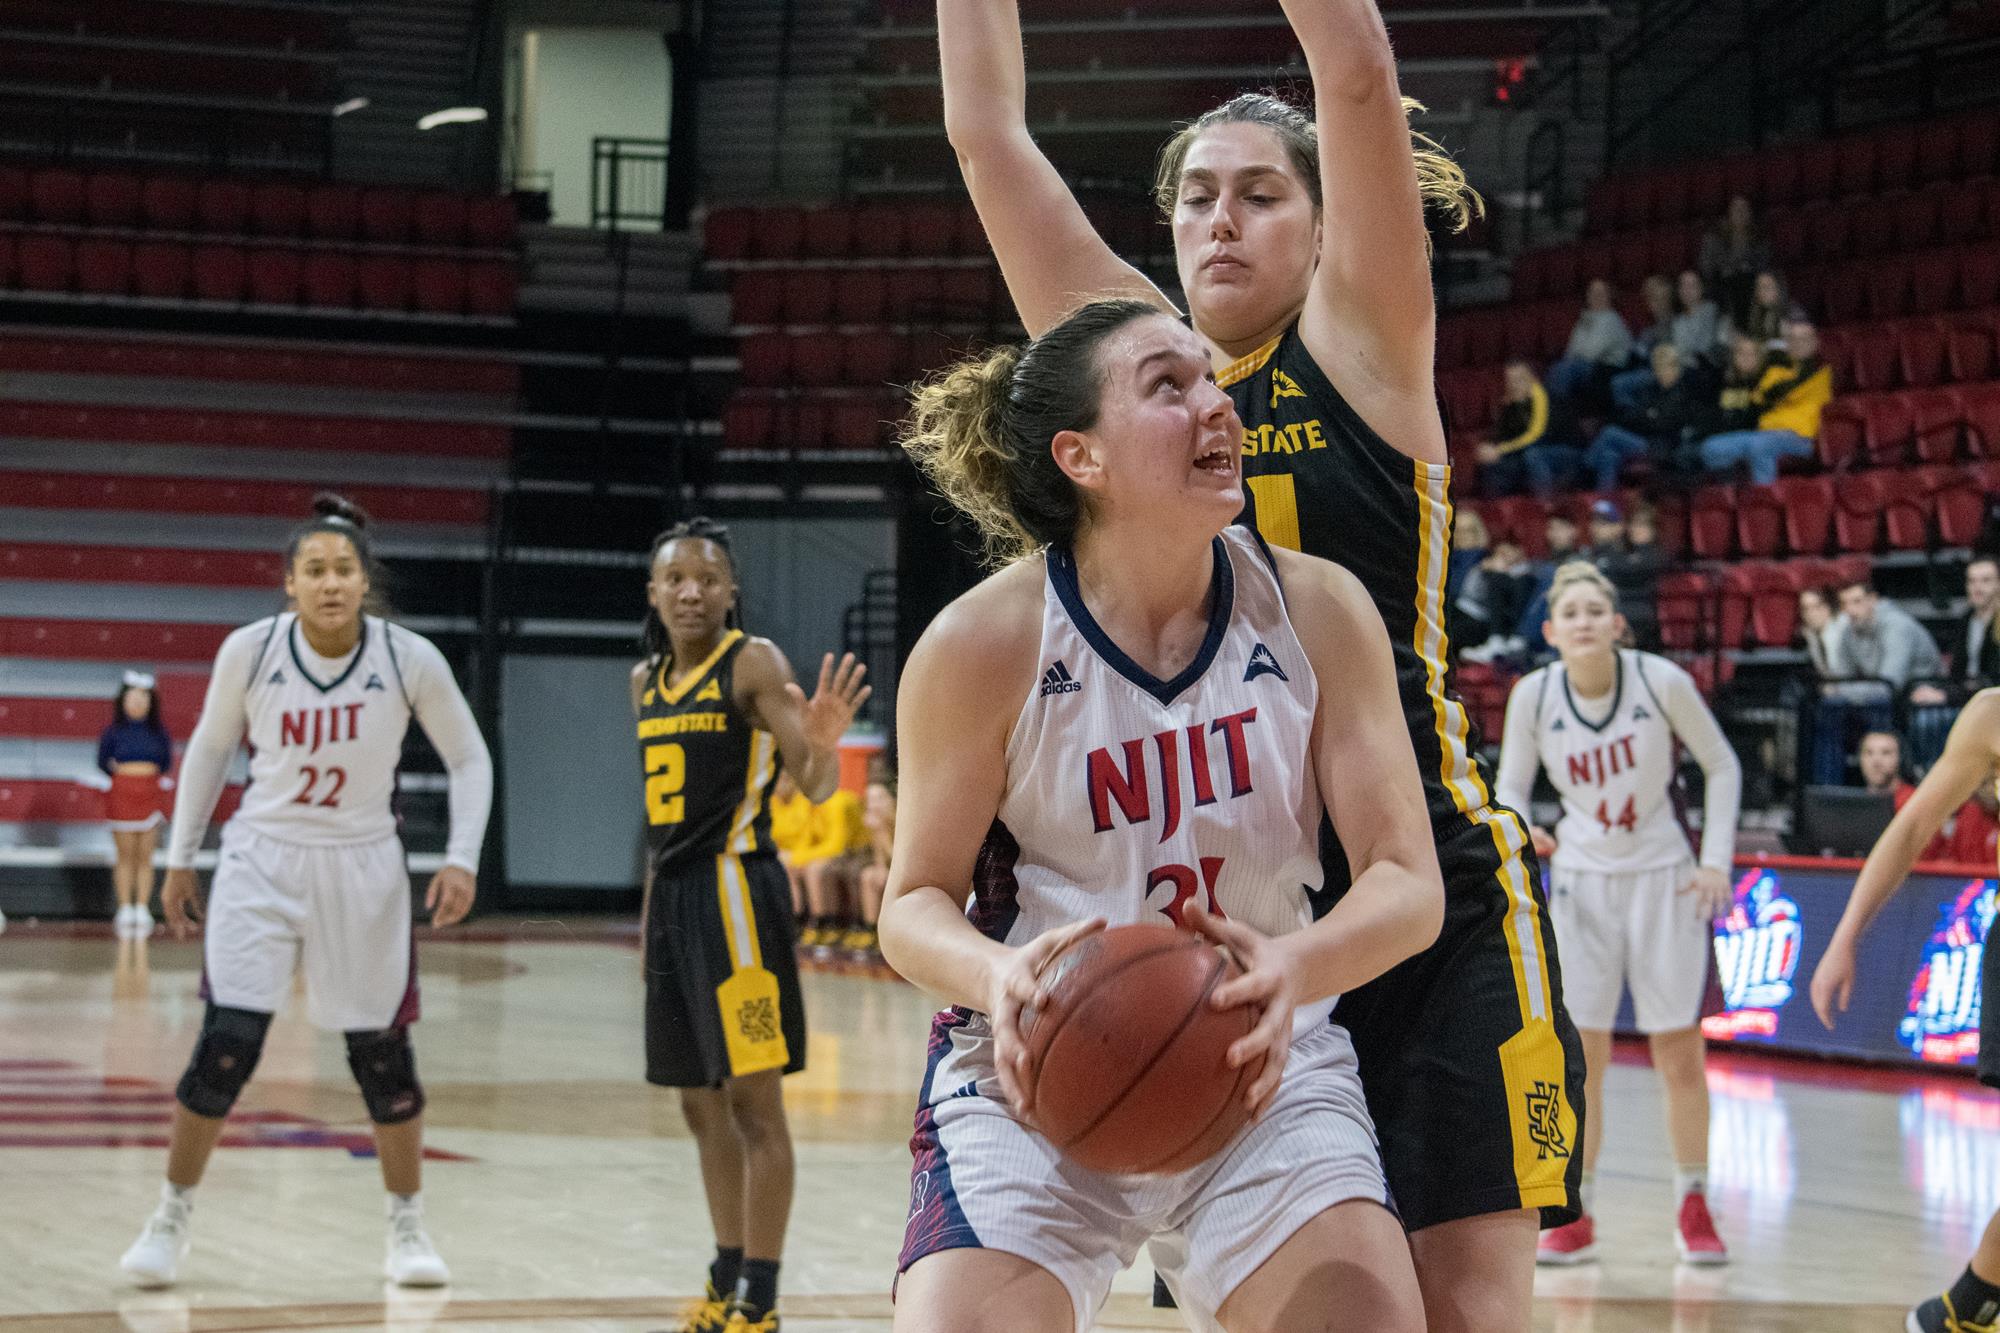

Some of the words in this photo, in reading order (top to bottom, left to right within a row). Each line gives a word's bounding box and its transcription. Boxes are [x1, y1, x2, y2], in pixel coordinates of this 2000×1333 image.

[1241, 419, 1327, 456] STATE
[281, 703, 364, 754] NJIT
[292, 765, 347, 808] 22
[645, 743, 686, 826] 2
[1087, 706, 1257, 845] NJIT
[1568, 734, 1634, 787] NJIT
[1595, 794, 1637, 833] 44
[1145, 856, 1226, 928] 31
[1926, 943, 1982, 1027] NJ
